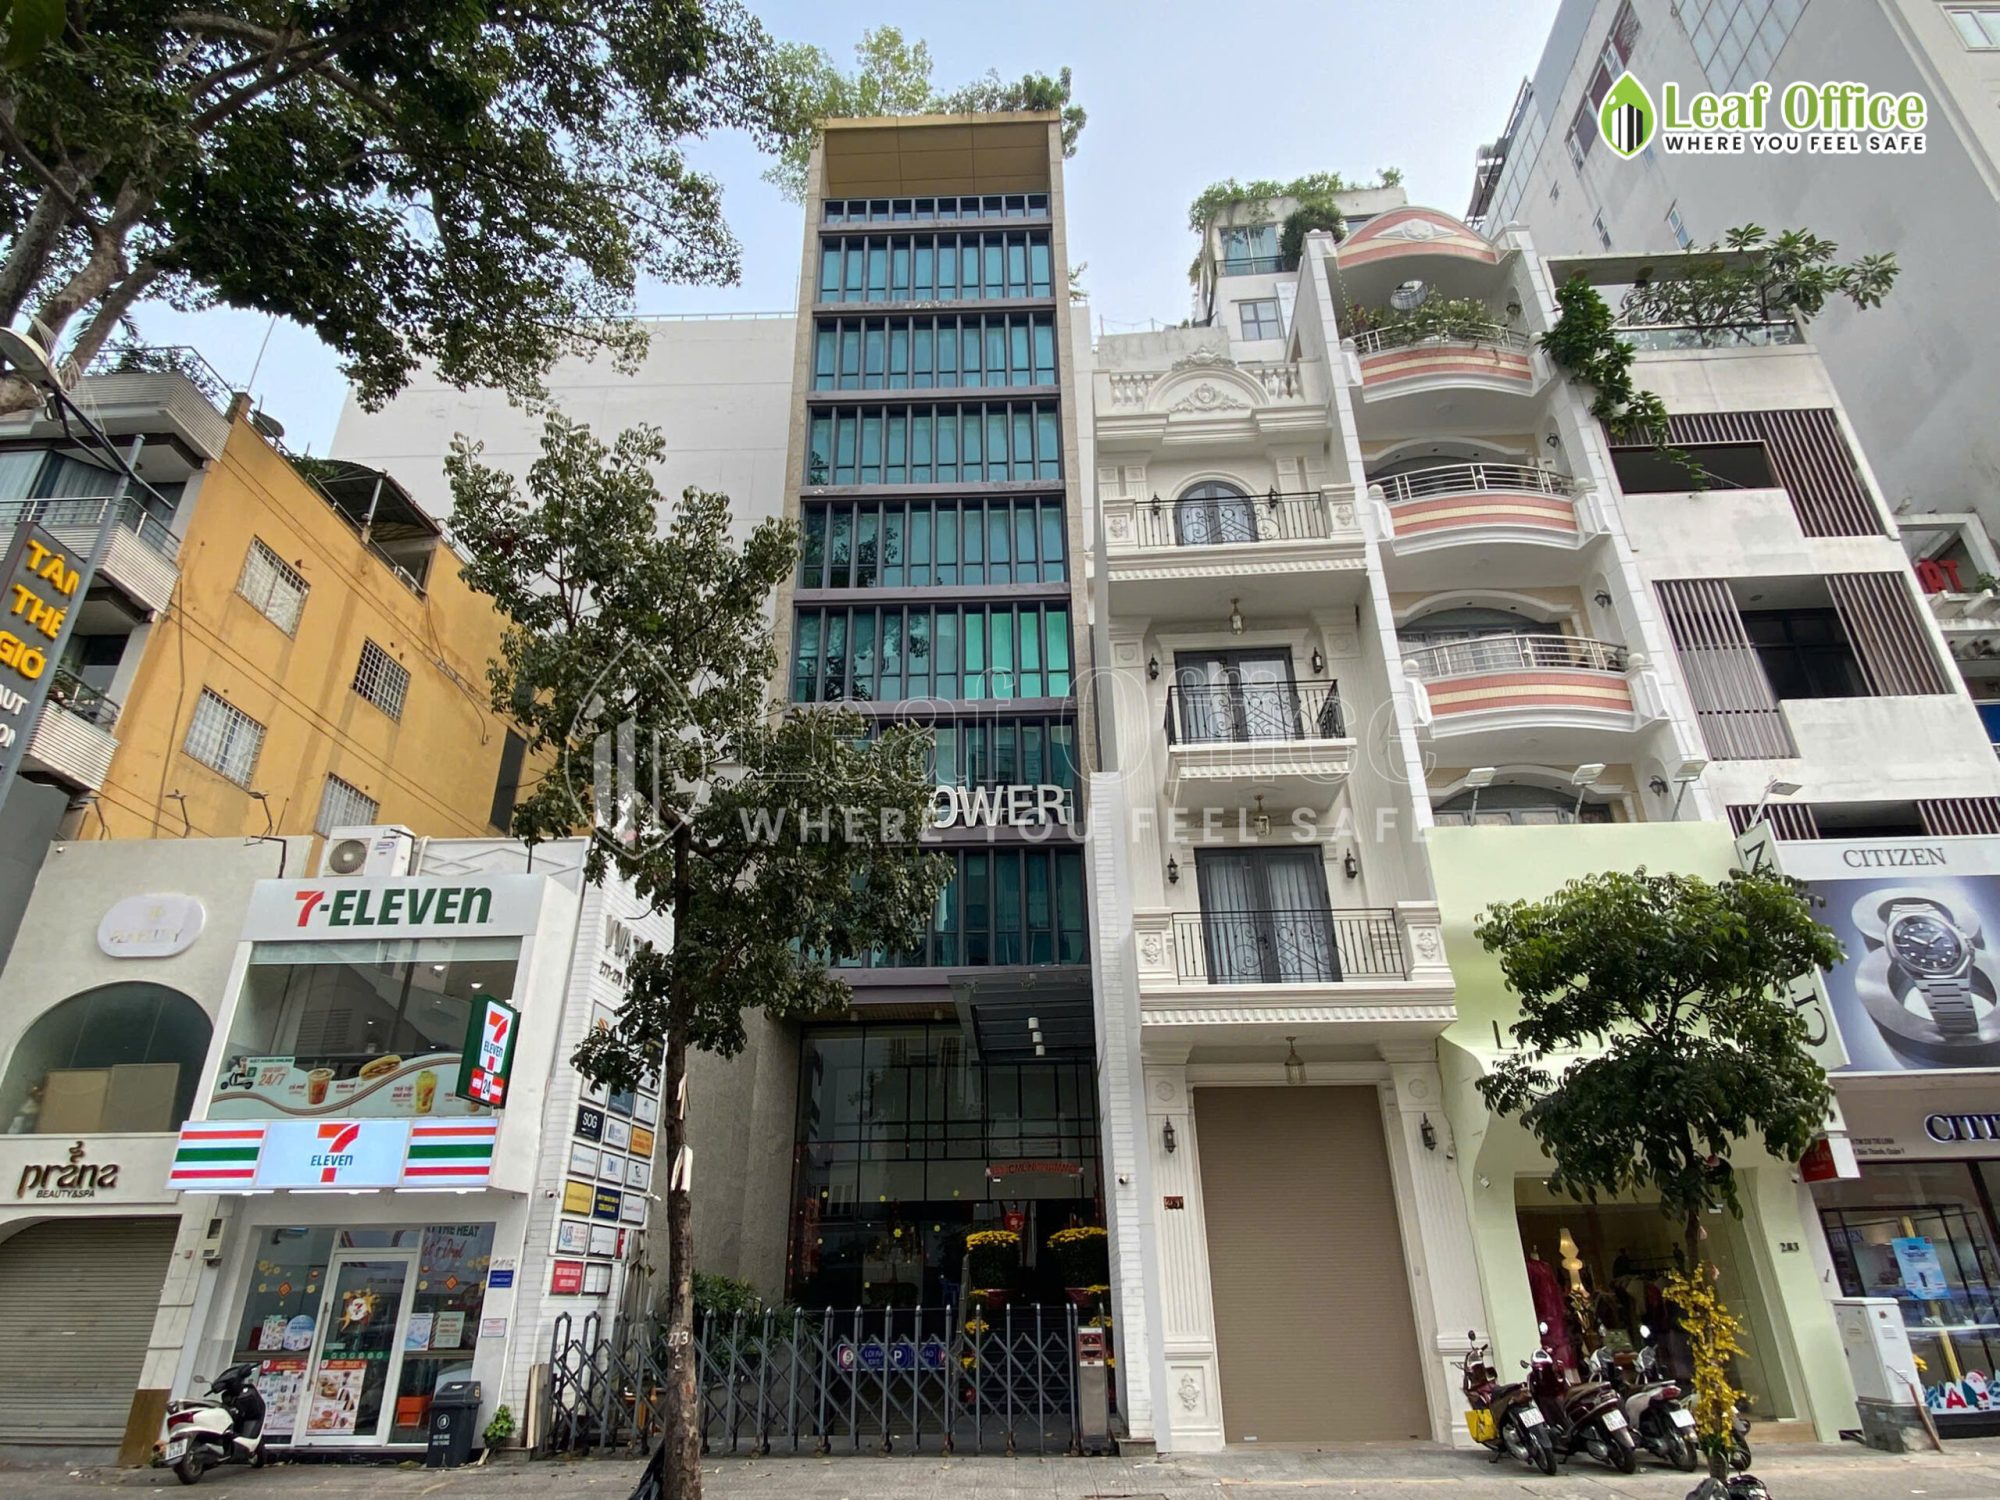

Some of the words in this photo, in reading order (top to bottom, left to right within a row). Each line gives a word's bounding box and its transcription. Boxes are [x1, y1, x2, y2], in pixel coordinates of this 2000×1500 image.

[930, 783, 1069, 829] OWER
[1842, 847, 1948, 869] CITIZEN
[582, 1112, 598, 1129] SOG
[893, 1350, 903, 1361] P
